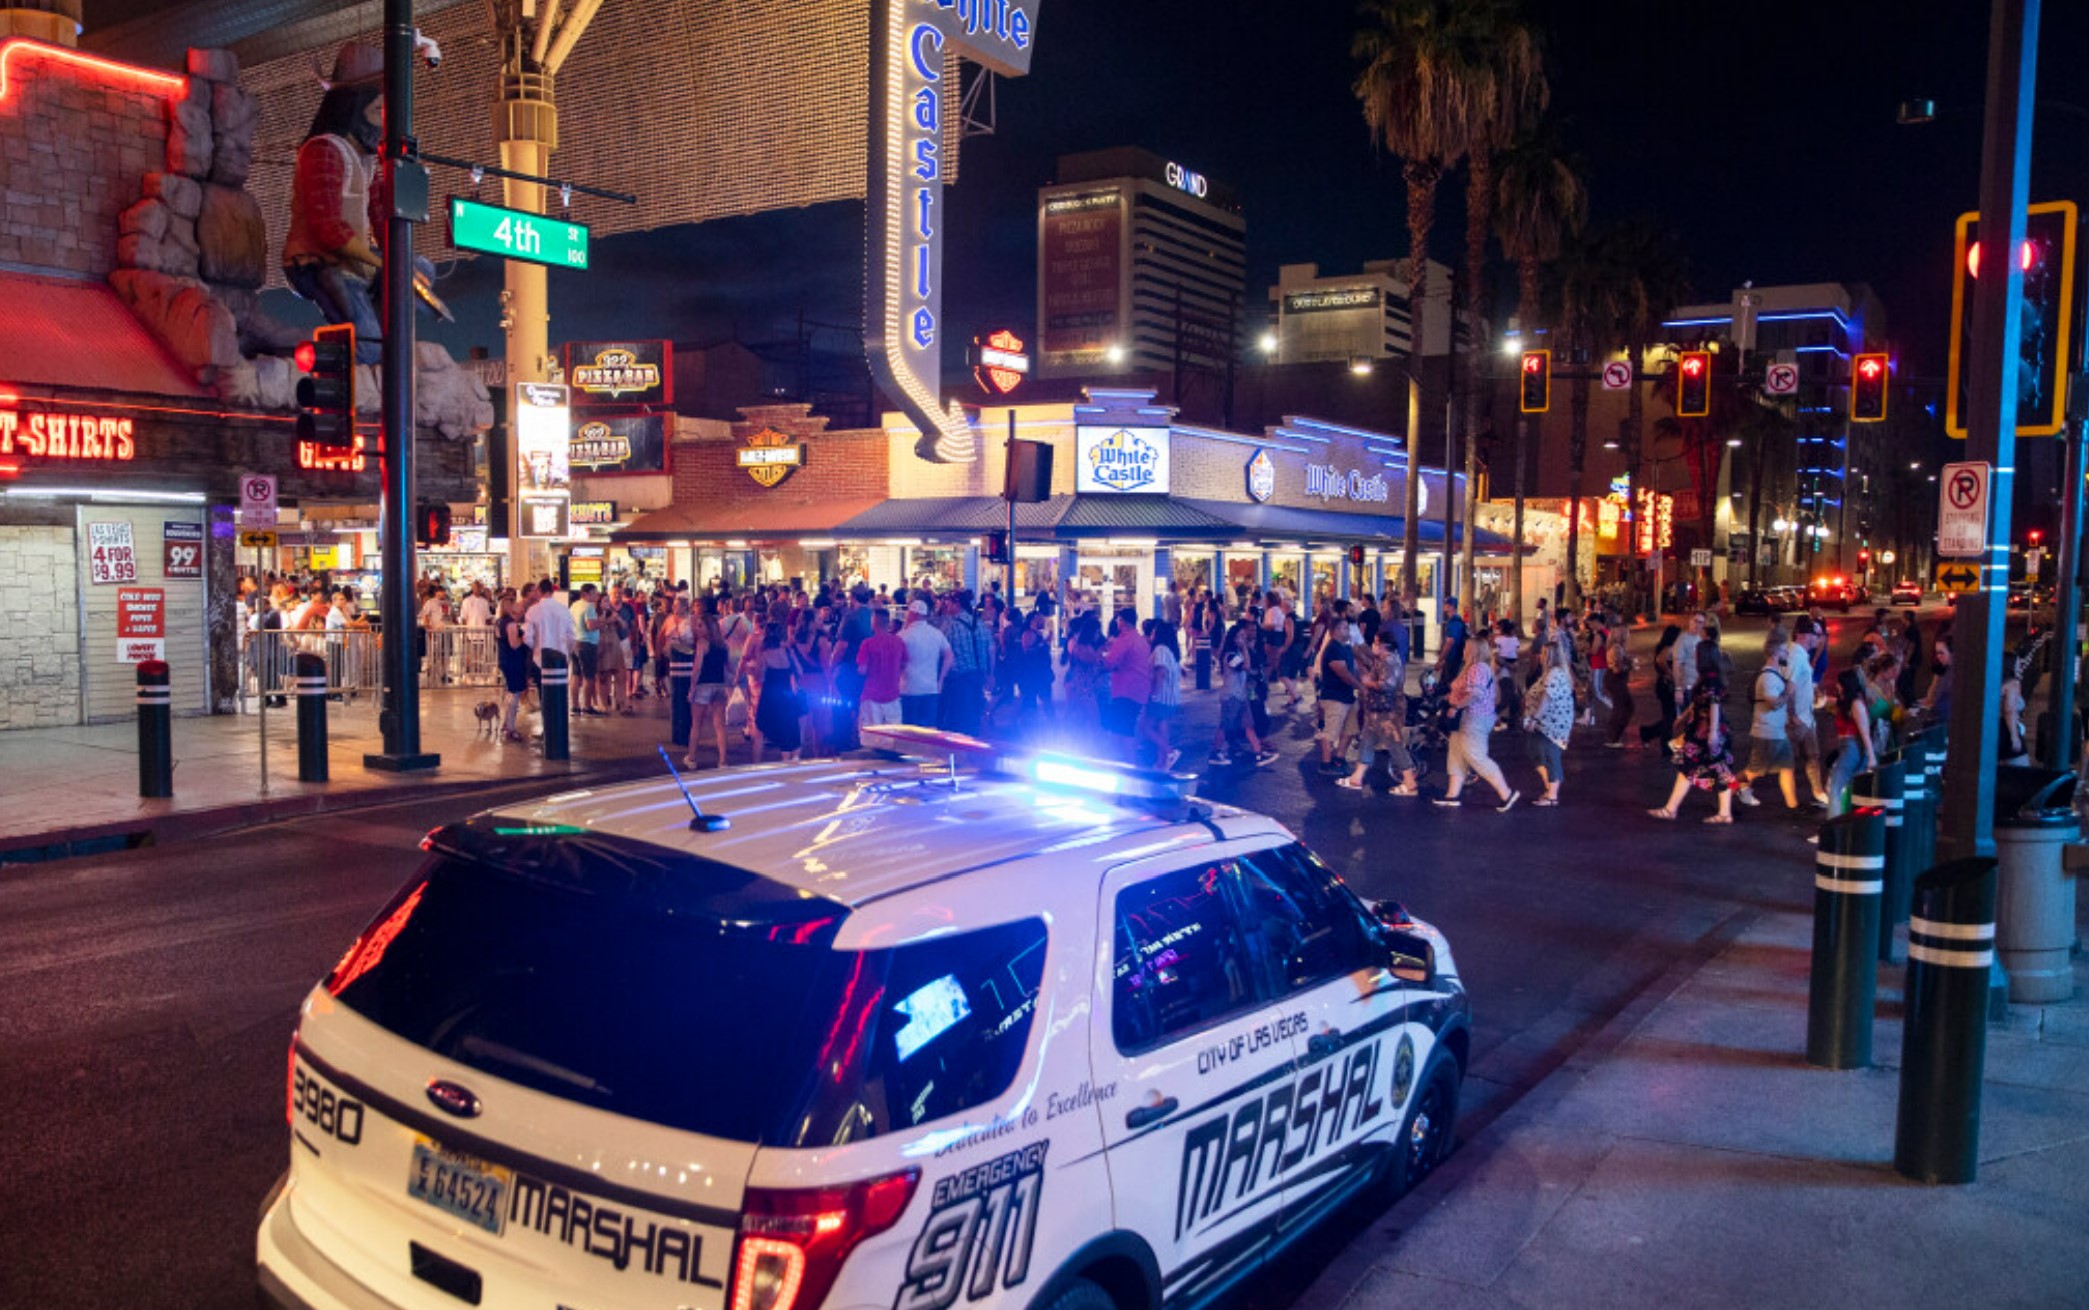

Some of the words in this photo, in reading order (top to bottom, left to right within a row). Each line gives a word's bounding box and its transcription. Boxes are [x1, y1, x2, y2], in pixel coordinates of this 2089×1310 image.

[910, 22, 945, 349] Castle
[456, 202, 464, 218] N
[493, 216, 540, 254] 4th
[568, 227, 579, 242] St
[567, 248, 586, 264] 100
[0, 410, 134, 460] T-SHIRTS
[1099, 448, 1151, 467] White
[1094, 465, 1153, 481] Castle
[1305, 463, 1347, 501] White
[1348, 469, 1389, 502] Castle
[93, 545, 107, 563] 4
[107, 545, 132, 562] FOR
[94, 562, 135, 581] $9.99
[1197, 1047, 1228, 1076] CITY
[1229, 1038, 1245, 1063] OF
[1246, 1024, 1272, 1054] LAS
[1271, 1010, 1310, 1046] VEGAS
[1021, 1105, 1039, 1130] to
[1046, 1081, 1119, 1120] Excellence
[1174, 1037, 1384, 1245] MARSHAL
[433, 1164, 500, 1223] 64524
[931, 1137, 1051, 1213] EMERGENCY
[509, 1175, 724, 1289] MARSHAL
[894, 1171, 1047, 1310] 911
